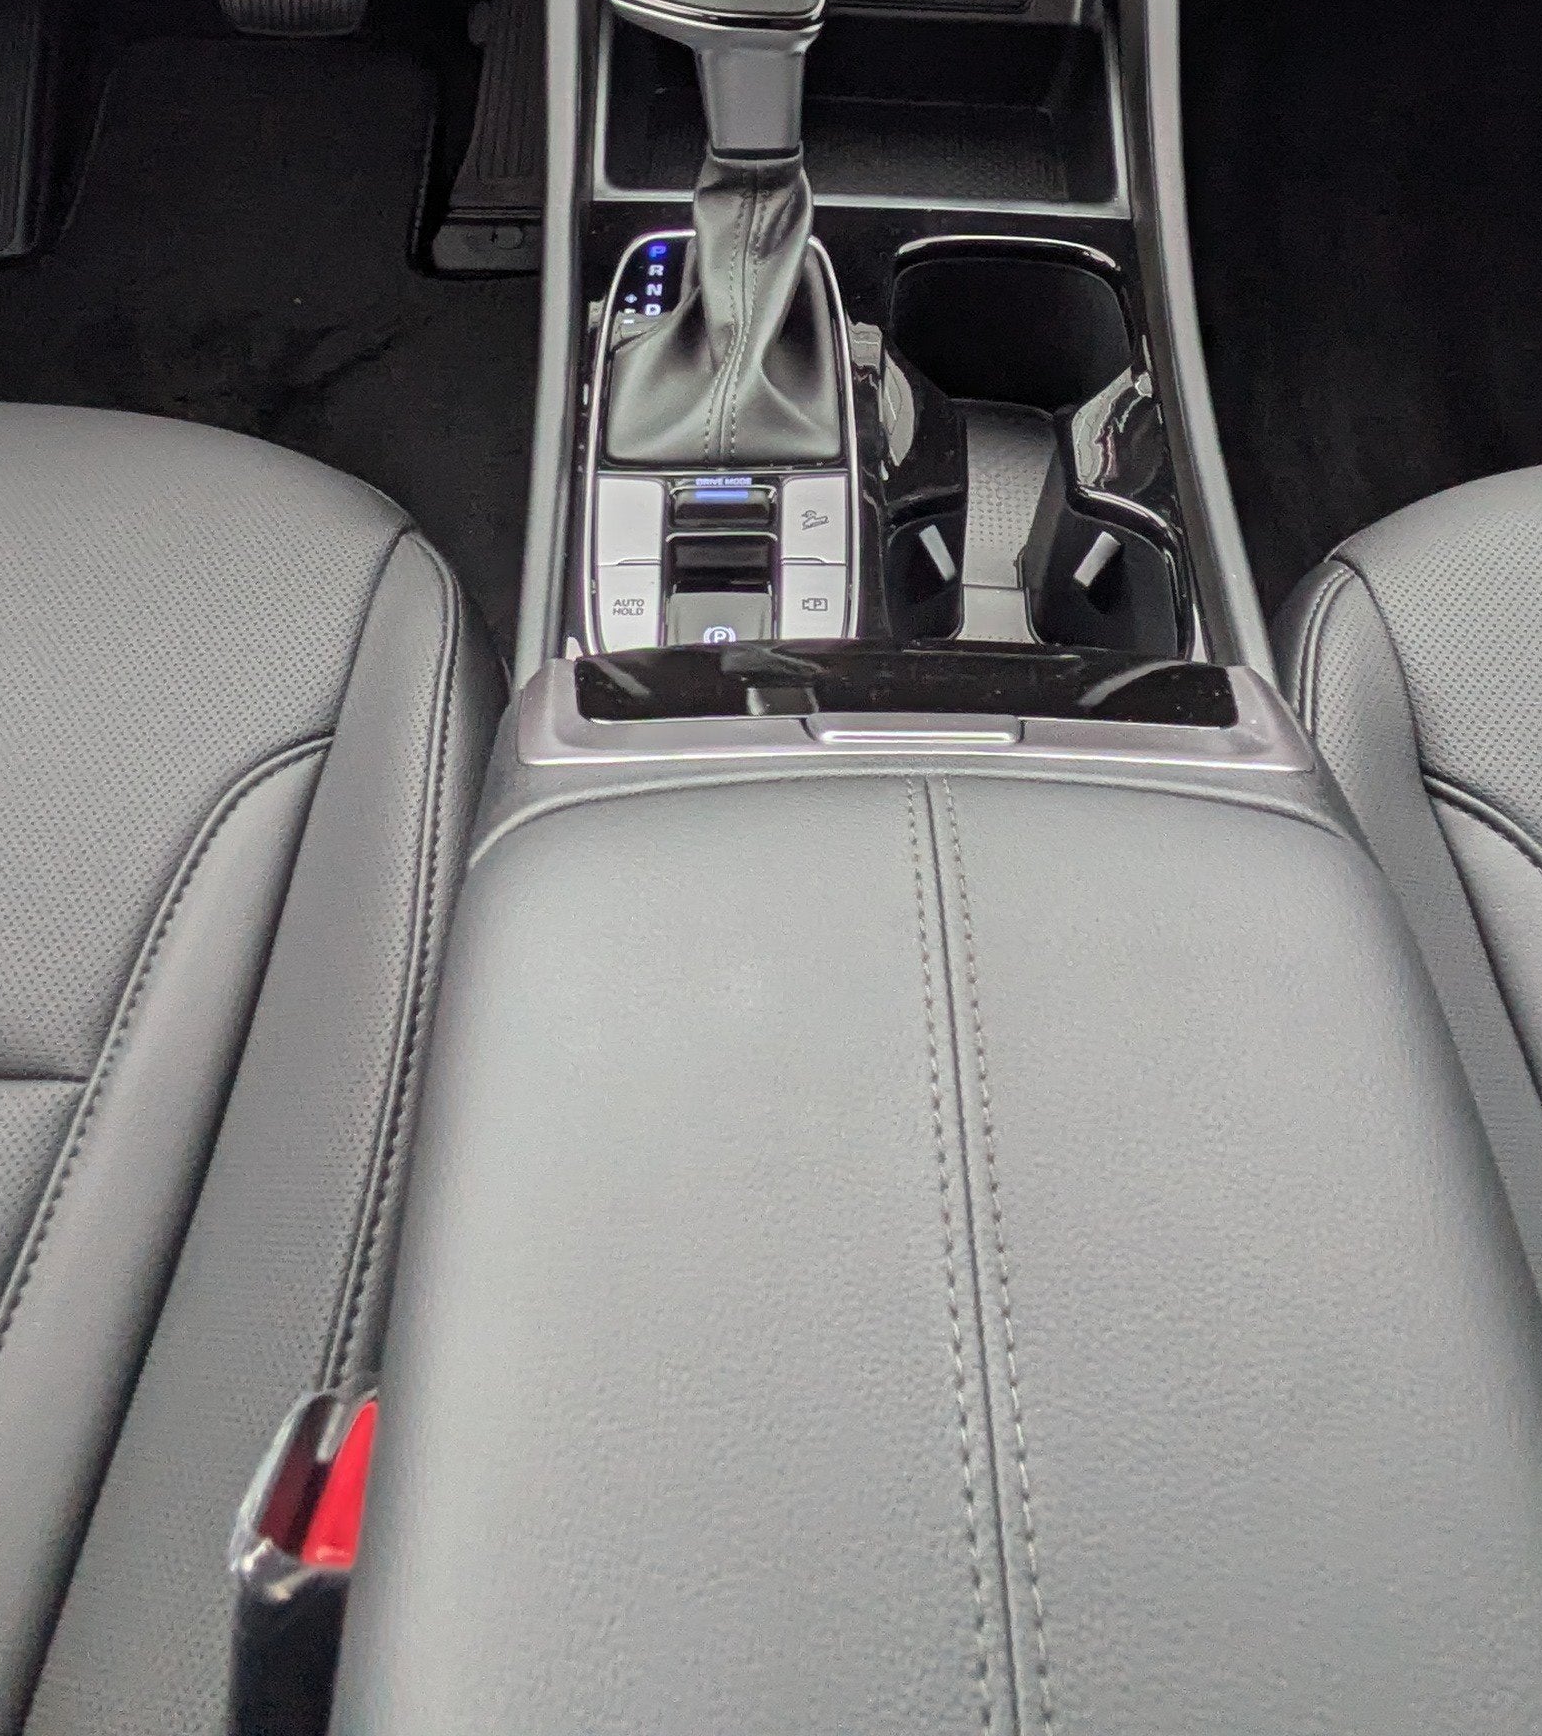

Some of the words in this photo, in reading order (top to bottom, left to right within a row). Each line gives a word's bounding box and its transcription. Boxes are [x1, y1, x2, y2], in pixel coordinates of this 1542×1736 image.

[649, 245, 666, 258] P
[648, 264, 664, 276] R
[646, 283, 663, 296] N
[644, 304, 661, 316] D
[613, 599, 645, 607] AUTO
[613, 607, 644, 616] HOLD
